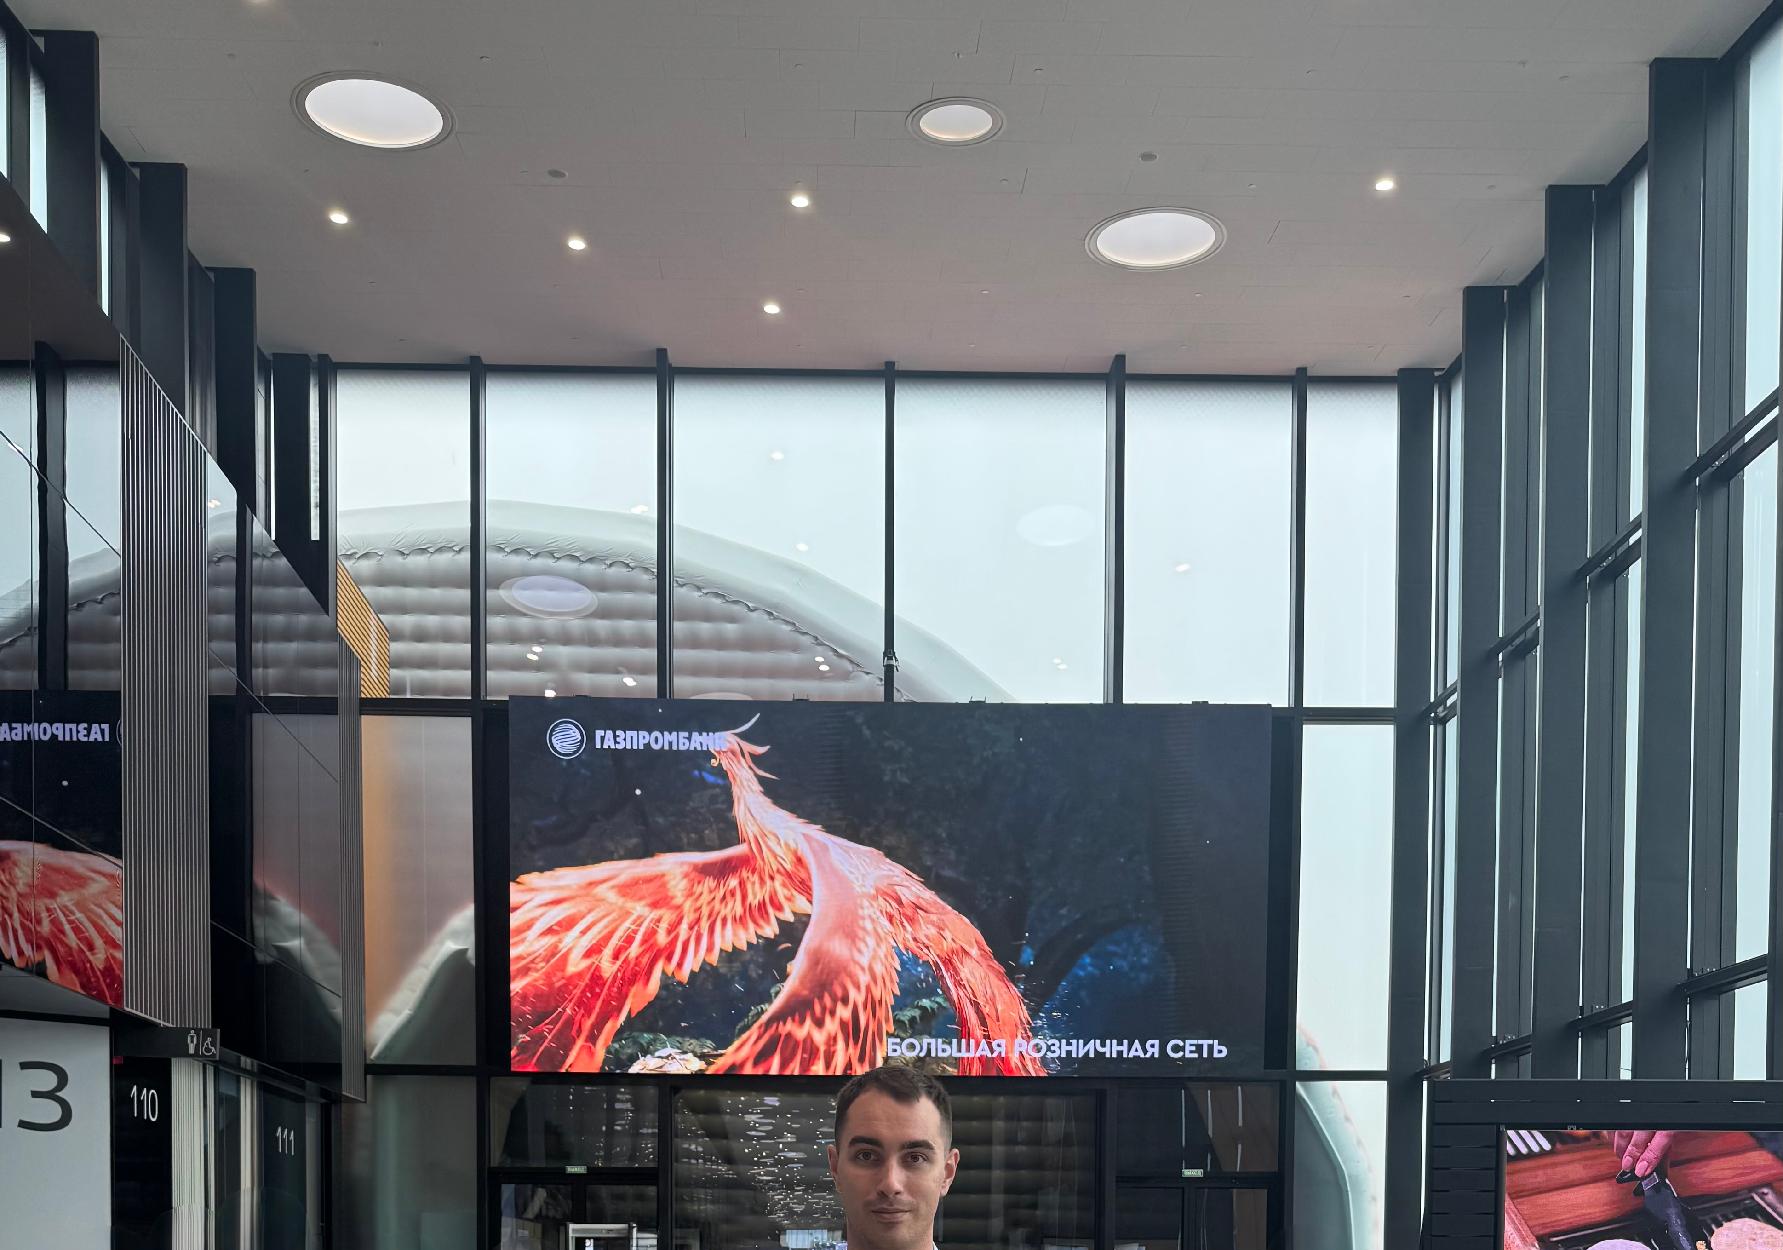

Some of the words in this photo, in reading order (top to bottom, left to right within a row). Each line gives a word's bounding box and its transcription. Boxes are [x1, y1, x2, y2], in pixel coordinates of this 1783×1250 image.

[887, 1037, 1006, 1058] БОЛЬШАЯ
[1014, 1038, 1159, 1059] РОЗНИЧНАЯ
[1166, 1039, 1228, 1059] СЕТЬ
[0, 1058, 73, 1132] 3
[130, 1084, 159, 1122] 110
[275, 1125, 295, 1156] 111
